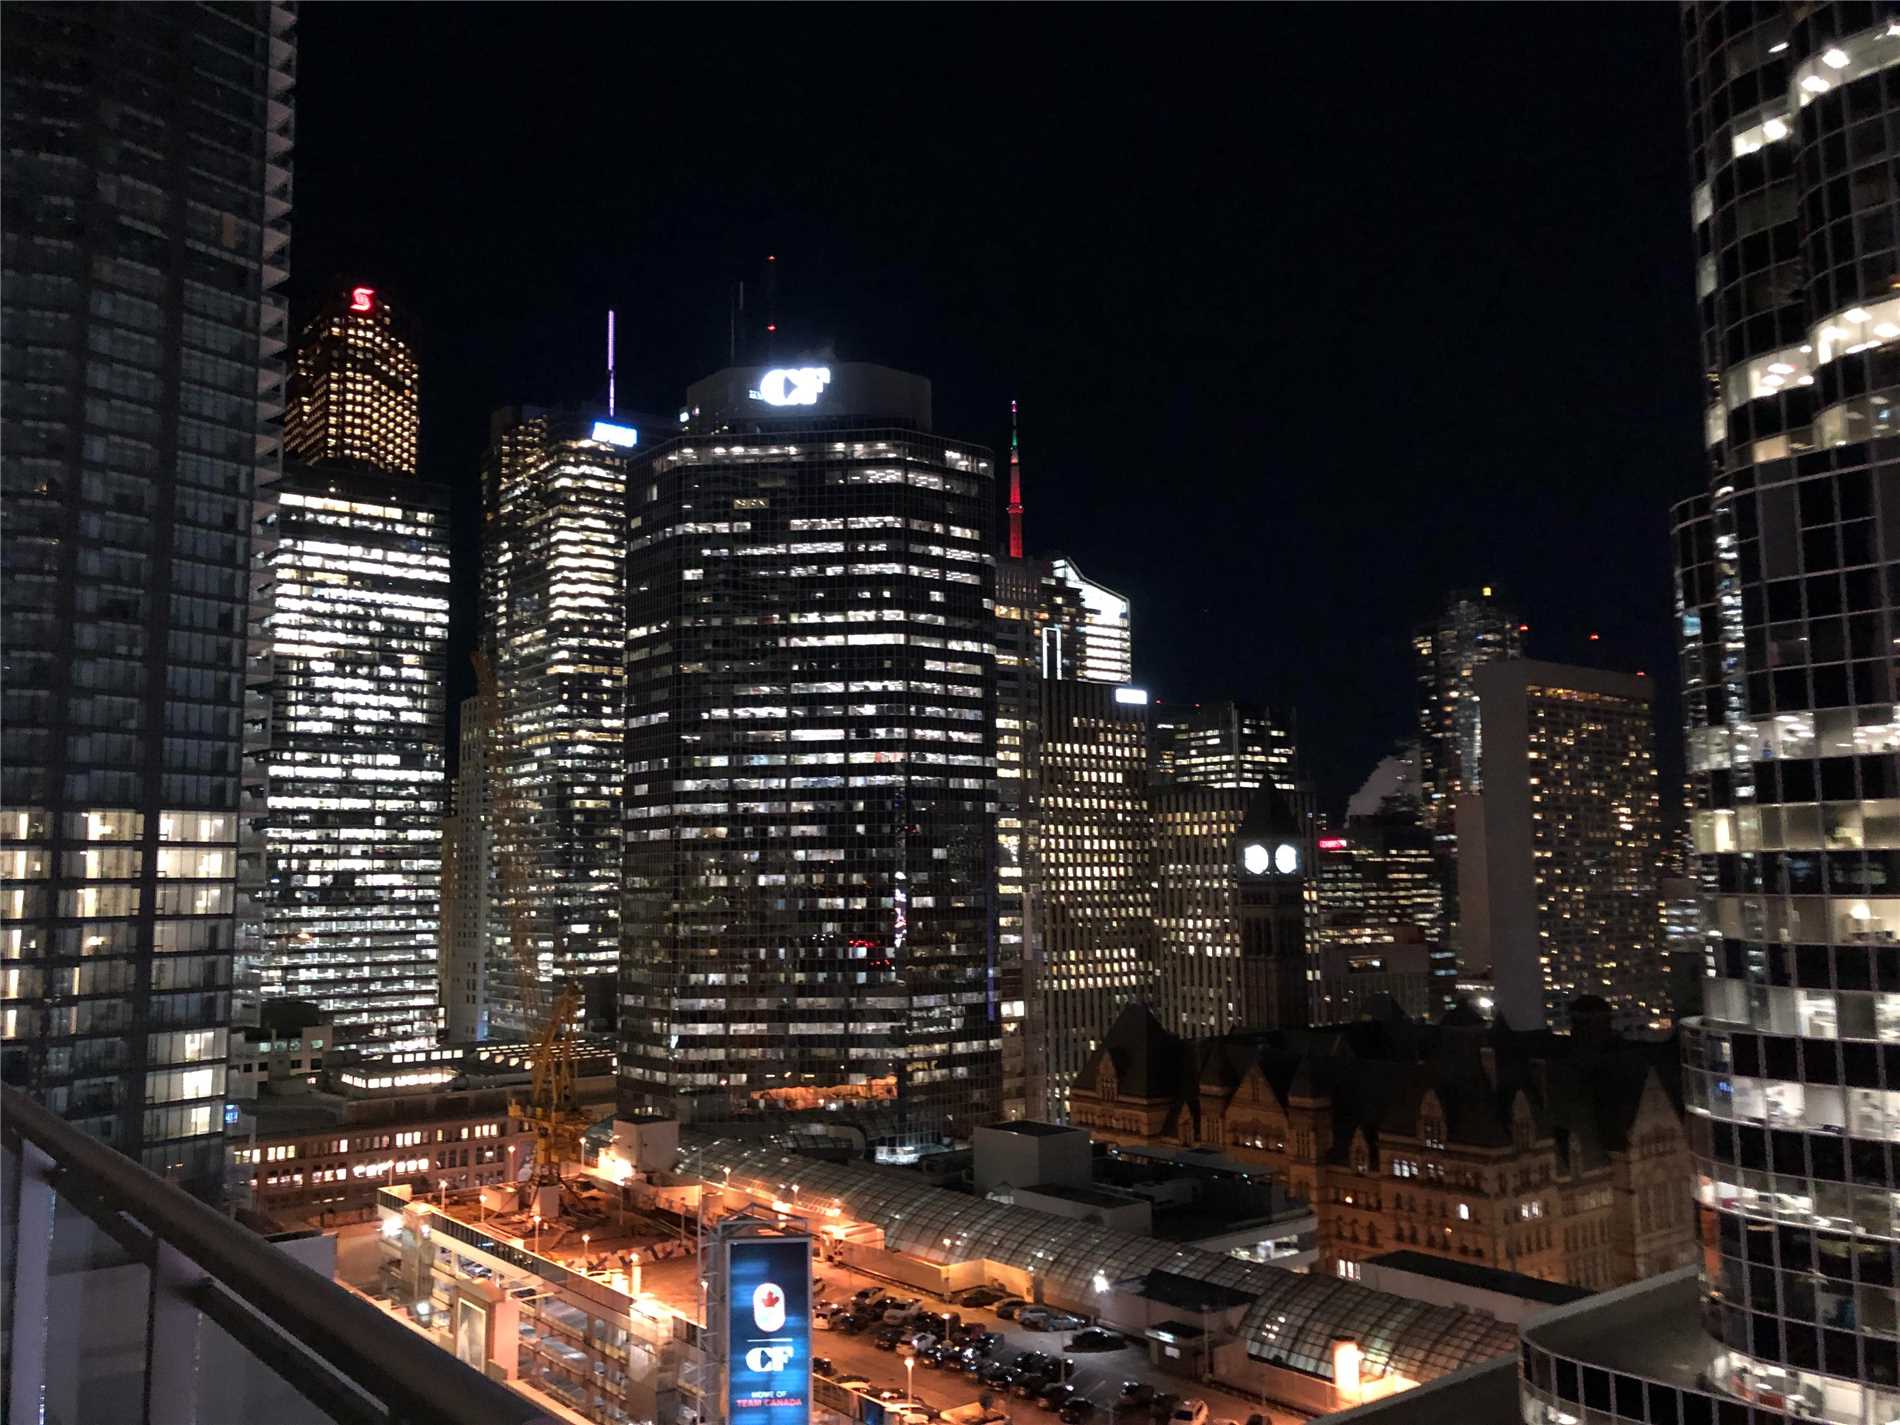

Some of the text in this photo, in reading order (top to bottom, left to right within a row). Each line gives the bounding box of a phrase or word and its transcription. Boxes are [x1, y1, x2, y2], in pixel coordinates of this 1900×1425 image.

[760, 367, 831, 406] CF
[745, 1346, 794, 1372] CF
[736, 1399, 761, 1407] TEAM
